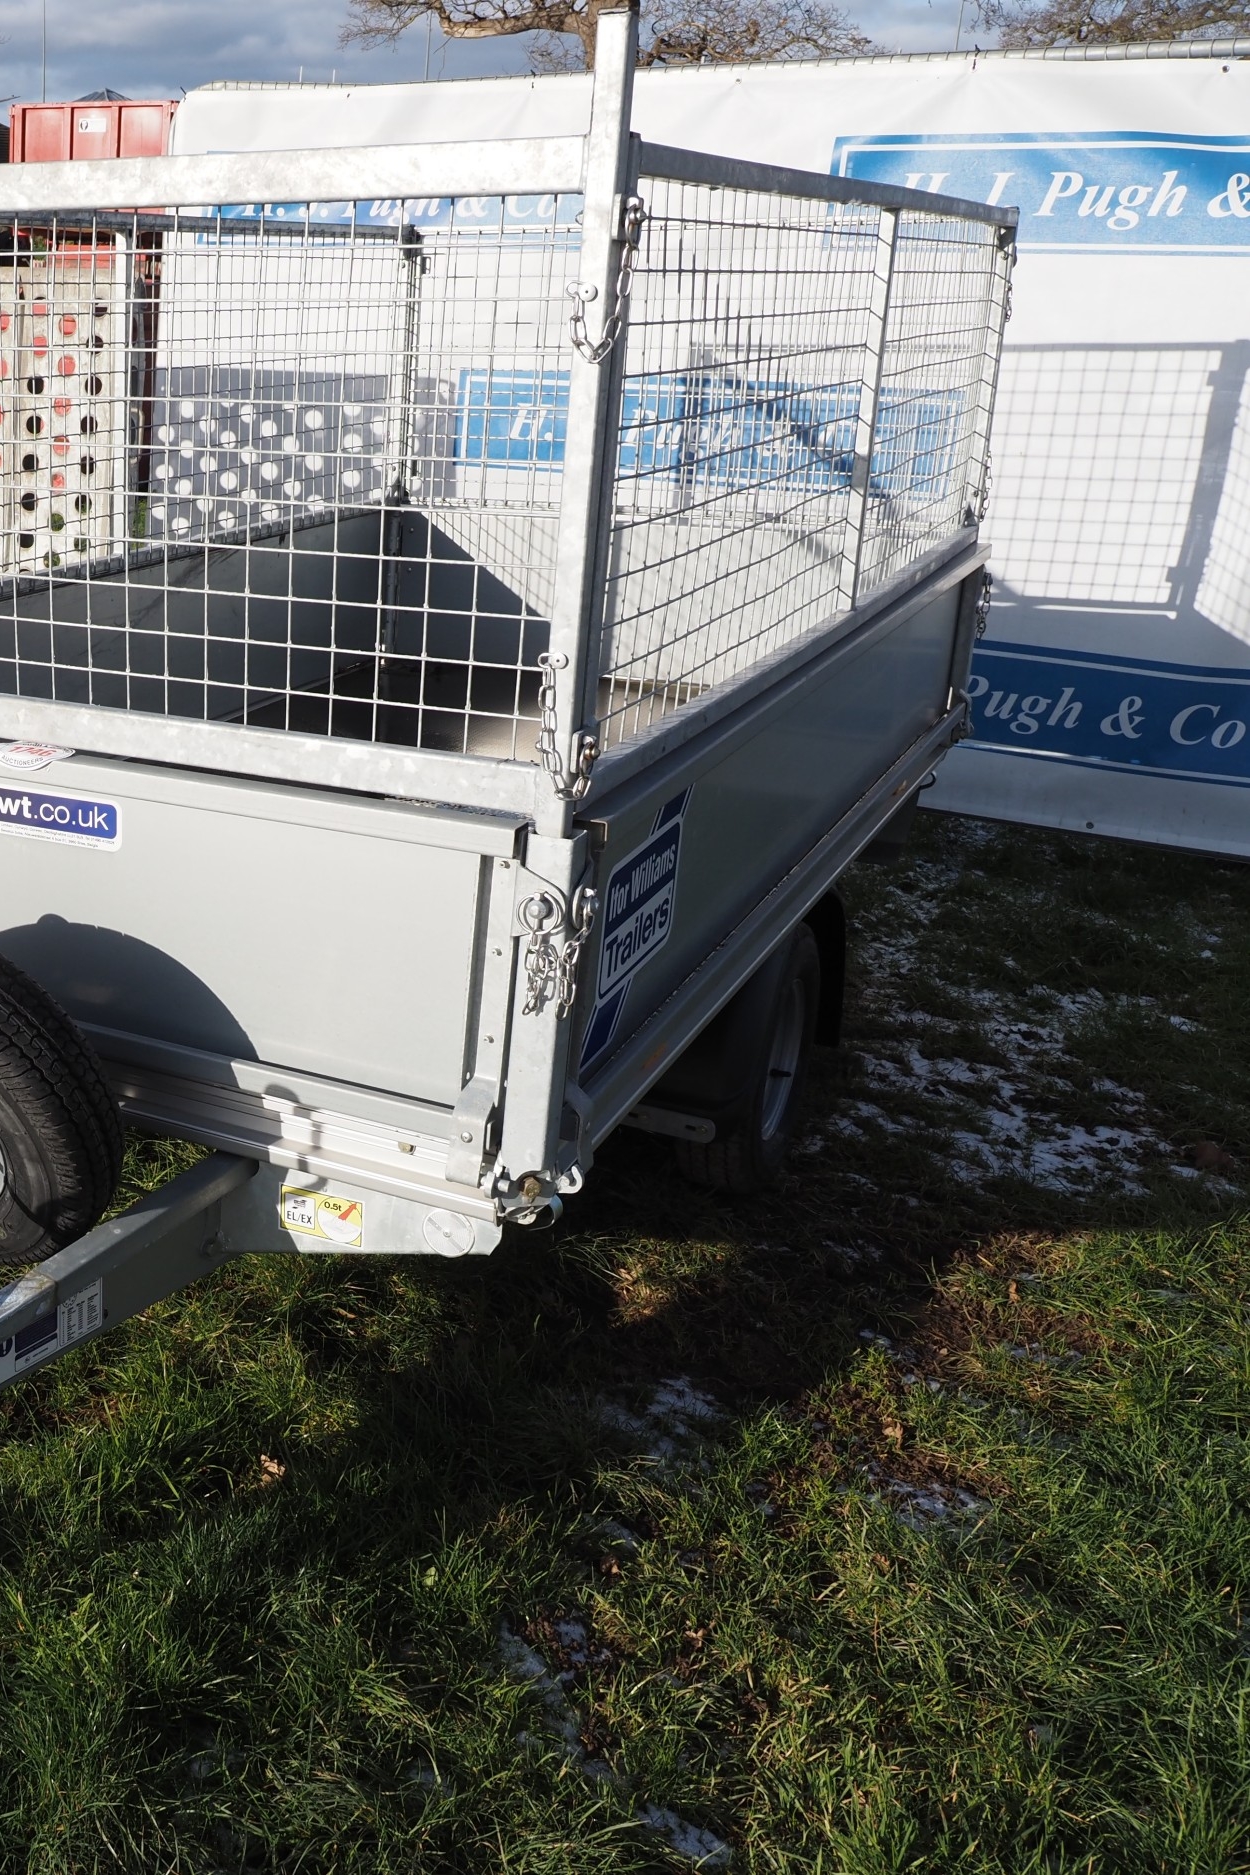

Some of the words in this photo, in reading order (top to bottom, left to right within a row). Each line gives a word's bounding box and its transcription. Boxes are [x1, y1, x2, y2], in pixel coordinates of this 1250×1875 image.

[1033, 170, 1187, 231] Pugh
[1207, 172, 1250, 218] &
[510, 402, 554, 441] H.
[1100, 696, 1146, 739] &
[1169, 704, 1246, 749] Co
[608, 881, 631, 922] Ifor
[630, 843, 676, 903] Williams
[606, 897, 671, 979] Trailers
[286, 1210, 313, 1225] EL/EX
[324, 1201, 342, 1212] 0.5t
